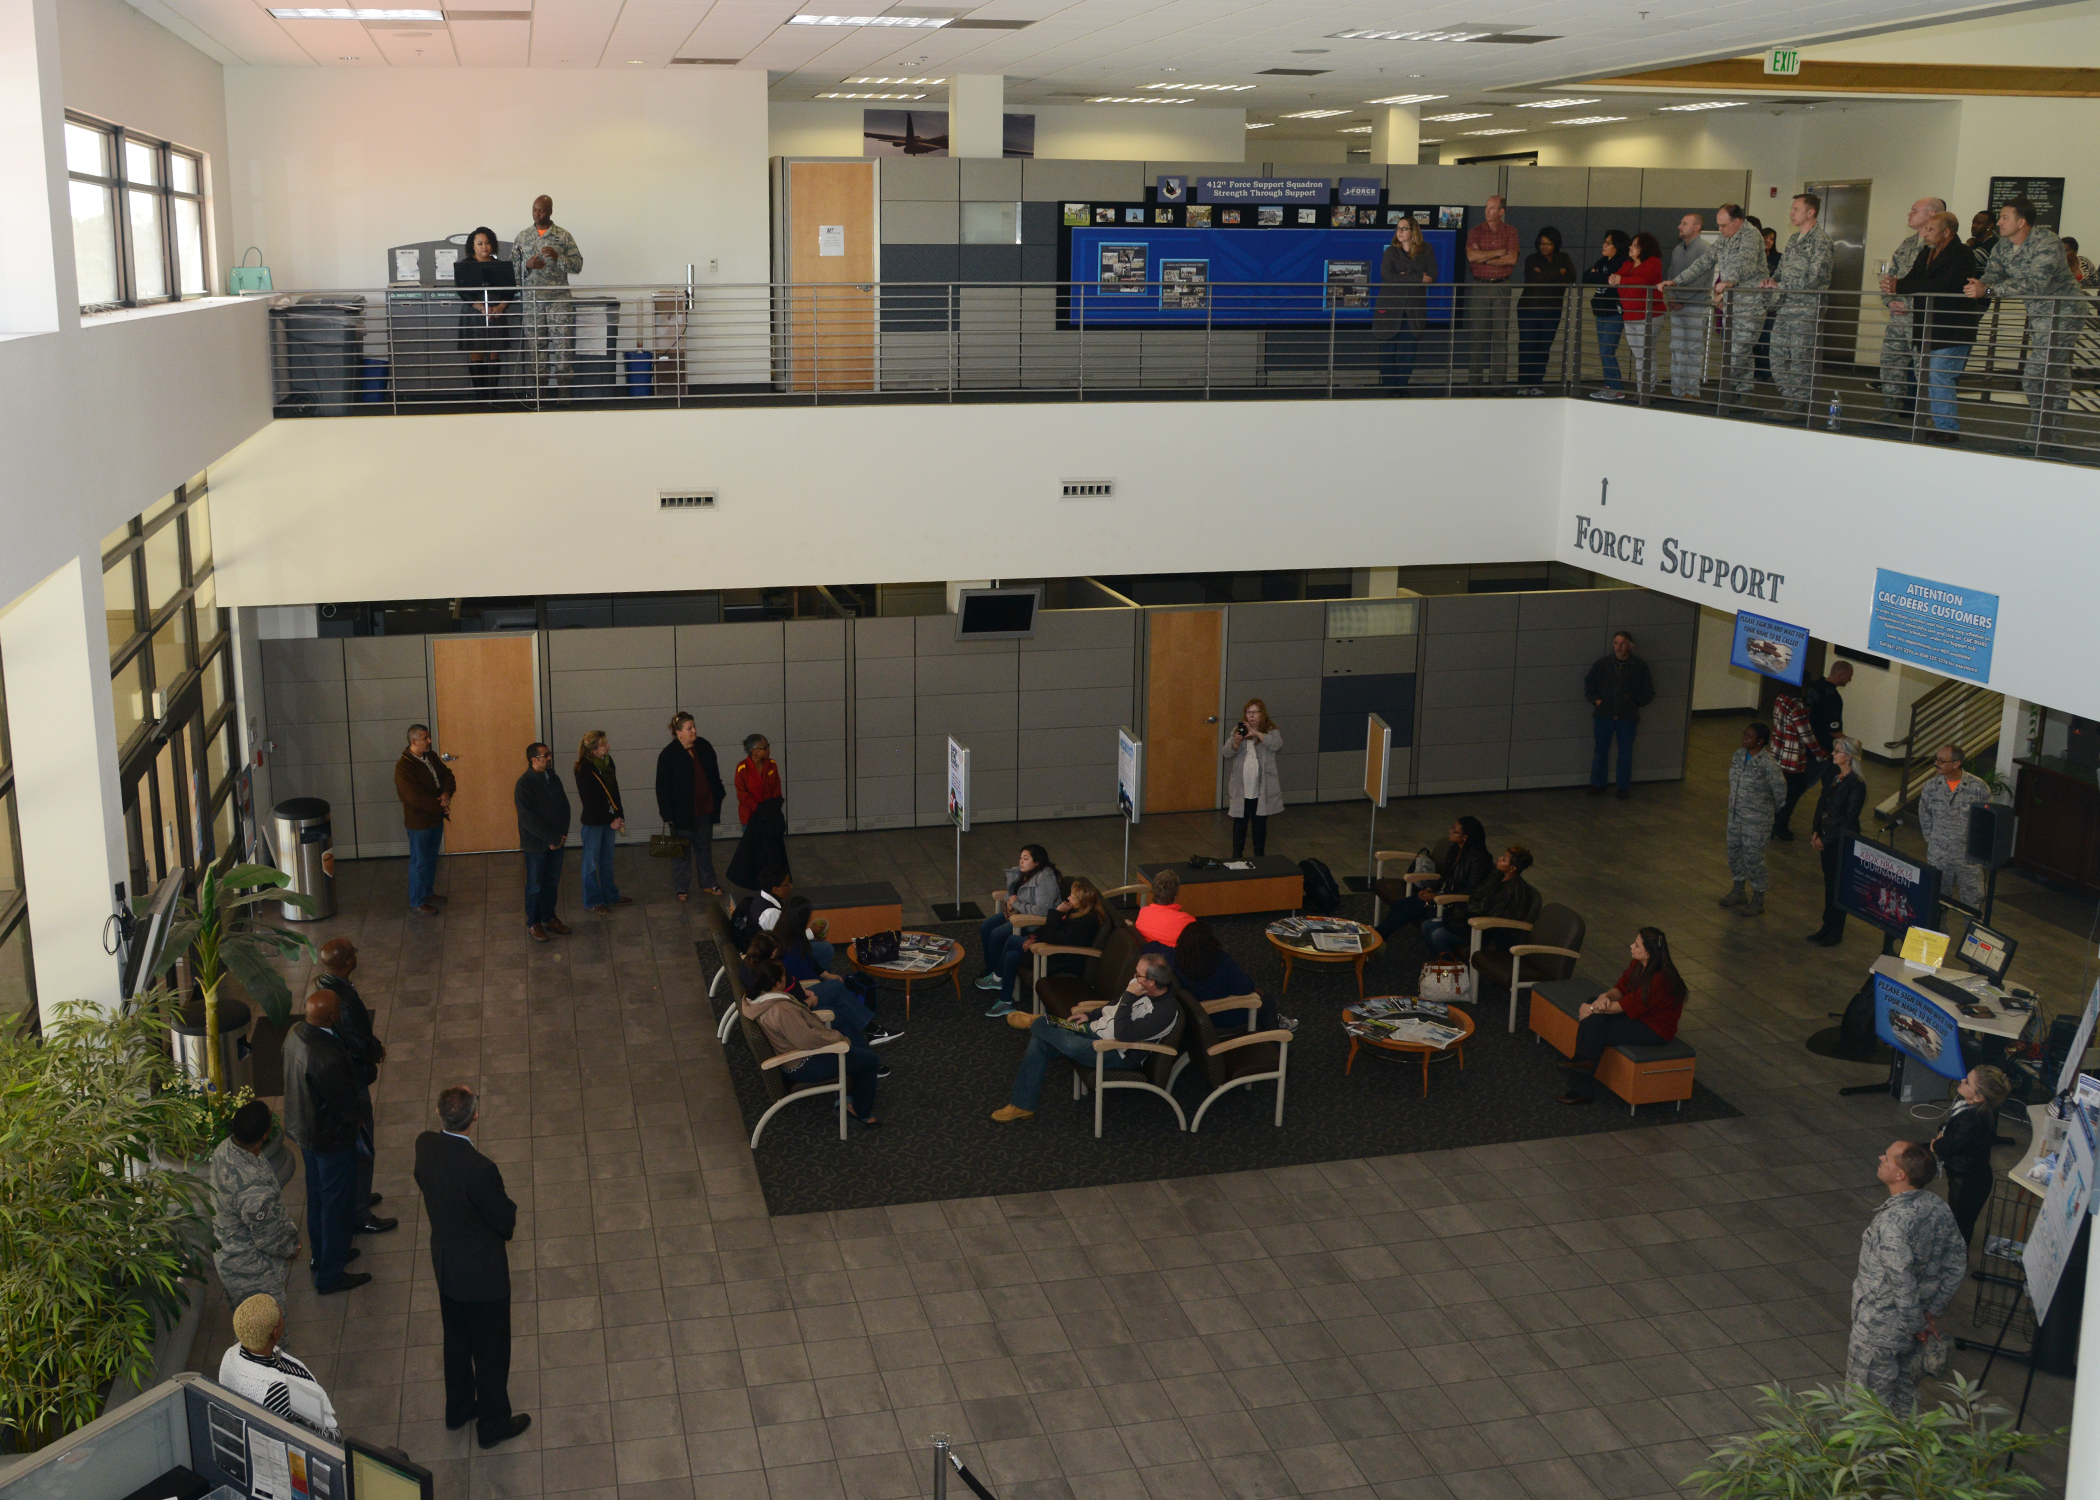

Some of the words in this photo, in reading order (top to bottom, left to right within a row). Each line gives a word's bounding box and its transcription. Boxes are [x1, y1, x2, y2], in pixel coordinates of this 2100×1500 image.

[1772, 51, 1798, 72] EXIT
[1213, 190, 1248, 198] Strength
[1250, 190, 1283, 198] Through
[1284, 190, 1316, 198] Support
[1253, 181, 1284, 190] Support
[1286, 181, 1323, 190] Squadron
[1906, 583, 1963, 606] ATTENTION
[1740, 616, 1755, 625] PLEASE
[1878, 590, 1929, 613] CAC/DEERS
[1931, 604, 1992, 629] CUSTOMERS
[1756, 629, 1768, 638] NAME
[1782, 637, 1798, 646] CALLED
[1860, 850, 1878, 864] XBOX
[1880, 860, 1894, 871] NBA
[1896, 866, 1913, 880] 2K16
[1860, 859, 1911, 888] TOURNAMENT
[1878, 981, 1900, 996] PLEASE
[1901, 992, 1915, 1002] SIGN
[1923, 1004, 1933, 1014] AND
[1934, 1010, 1945, 1022] WAIT
[1945, 1019, 1954, 1031] FOR
[1884, 994, 1900, 1006] YOUR
[1901, 1003, 1918, 1015] NAME
[1926, 1017, 1931, 1025] BE
[1932, 1020, 1947, 1037] CALLED
